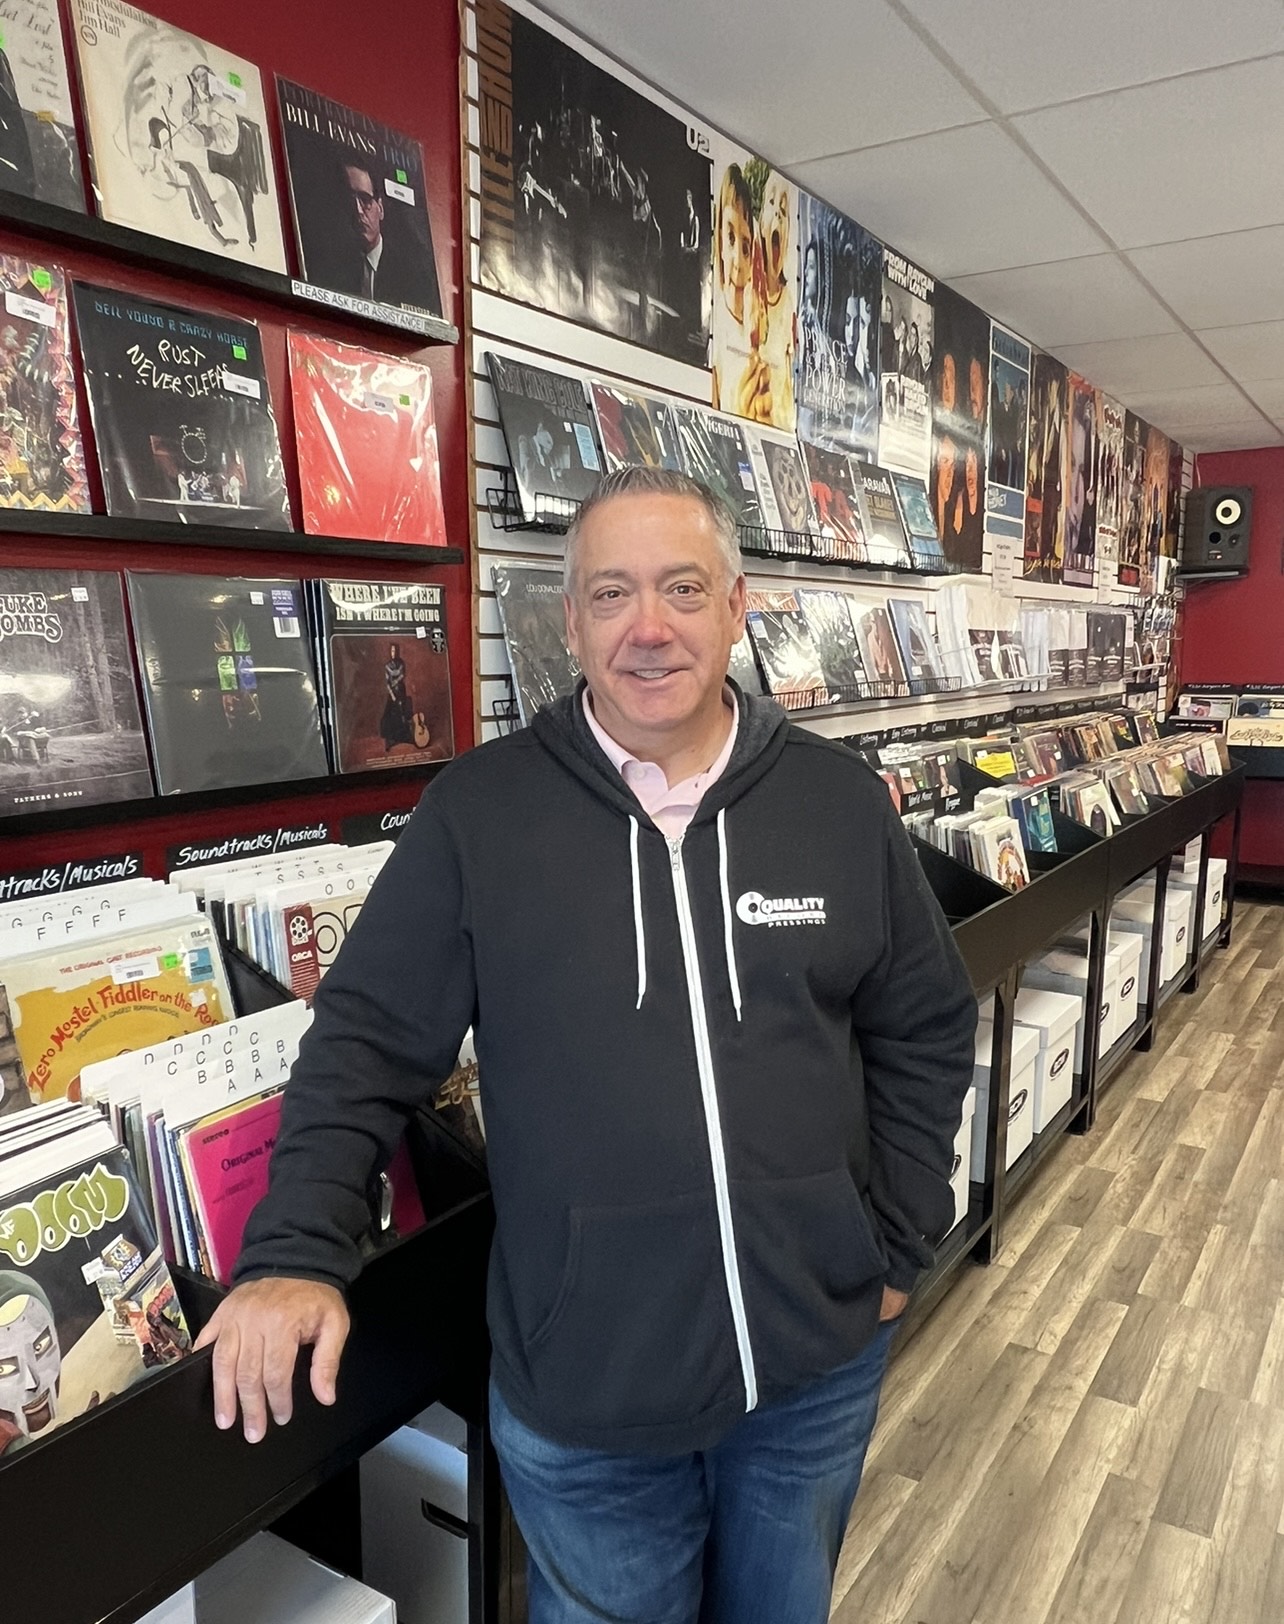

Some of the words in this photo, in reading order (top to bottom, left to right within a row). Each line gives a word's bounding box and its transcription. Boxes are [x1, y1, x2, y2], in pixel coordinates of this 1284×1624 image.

[79, 9, 98, 28] Jim
[98, 18, 121, 38] Hall
[96, 4, 127, 28] Evans
[286, 102, 325, 135] BILL
[328, 120, 378, 156] EVANS
[383, 145, 418, 172] TRIO
[884, 249, 907, 274] FROM
[887, 265, 907, 288] WITH
[909, 278, 927, 300] LOVE
[293, 282, 331, 303] PLEASE
[331, 295, 350, 308] ASK
[351, 299, 370, 314] FOR
[179, 321, 212, 339] CRAZY
[157, 339, 206, 367] RUST
[126, 344, 183, 395] NEVER
[805, 365, 846, 402] POWER
[329, 583, 380, 603] WHERE
[410, 586, 441, 605] BEEN
[0, 612, 63, 643] OMBS
[363, 608, 398, 622] WHERE
[398, 608, 414, 622] I'M
[414, 609, 440, 622] GOING
[14, 793, 52, 805] FATHERS
[63, 790, 84, 799] SONS
[380, 807, 416, 831] Coun
[175, 823, 328, 866] Soundtracks/Musicals
[760, 897, 825, 914] QUALITY
[37, 927, 46, 941] F
[65, 921, 74, 934] F
[92, 914, 100, 928] F
[118, 909, 126, 922] F
[767, 918, 826, 929] PRESSINGS
[59, 965, 73, 975] THE
[74, 959, 105, 972] ORIGINAL
[106, 954, 123, 964] CAST
[125, 946, 163, 959] RECORDING
[27, 1047, 56, 1093] Zero
[50, 997, 100, 1052] Mostel
[96, 982, 159, 1011] Fiddler
[159, 991, 173, 1004] on
[173, 989, 192, 1012] the
[167, 1062, 177, 1076] C
[196, 1051, 206, 1065] C
[223, 1041, 233, 1055] C
[250, 1031, 259, 1045] C
[198, 1070, 207, 1084] B
[225, 1059, 234, 1074] B
[251, 1049, 260, 1063] B
[276, 1040, 285, 1053] B
[228, 1079, 237, 1093] A
[254, 1068, 263, 1082] A
[279, 1058, 288, 1071] A
